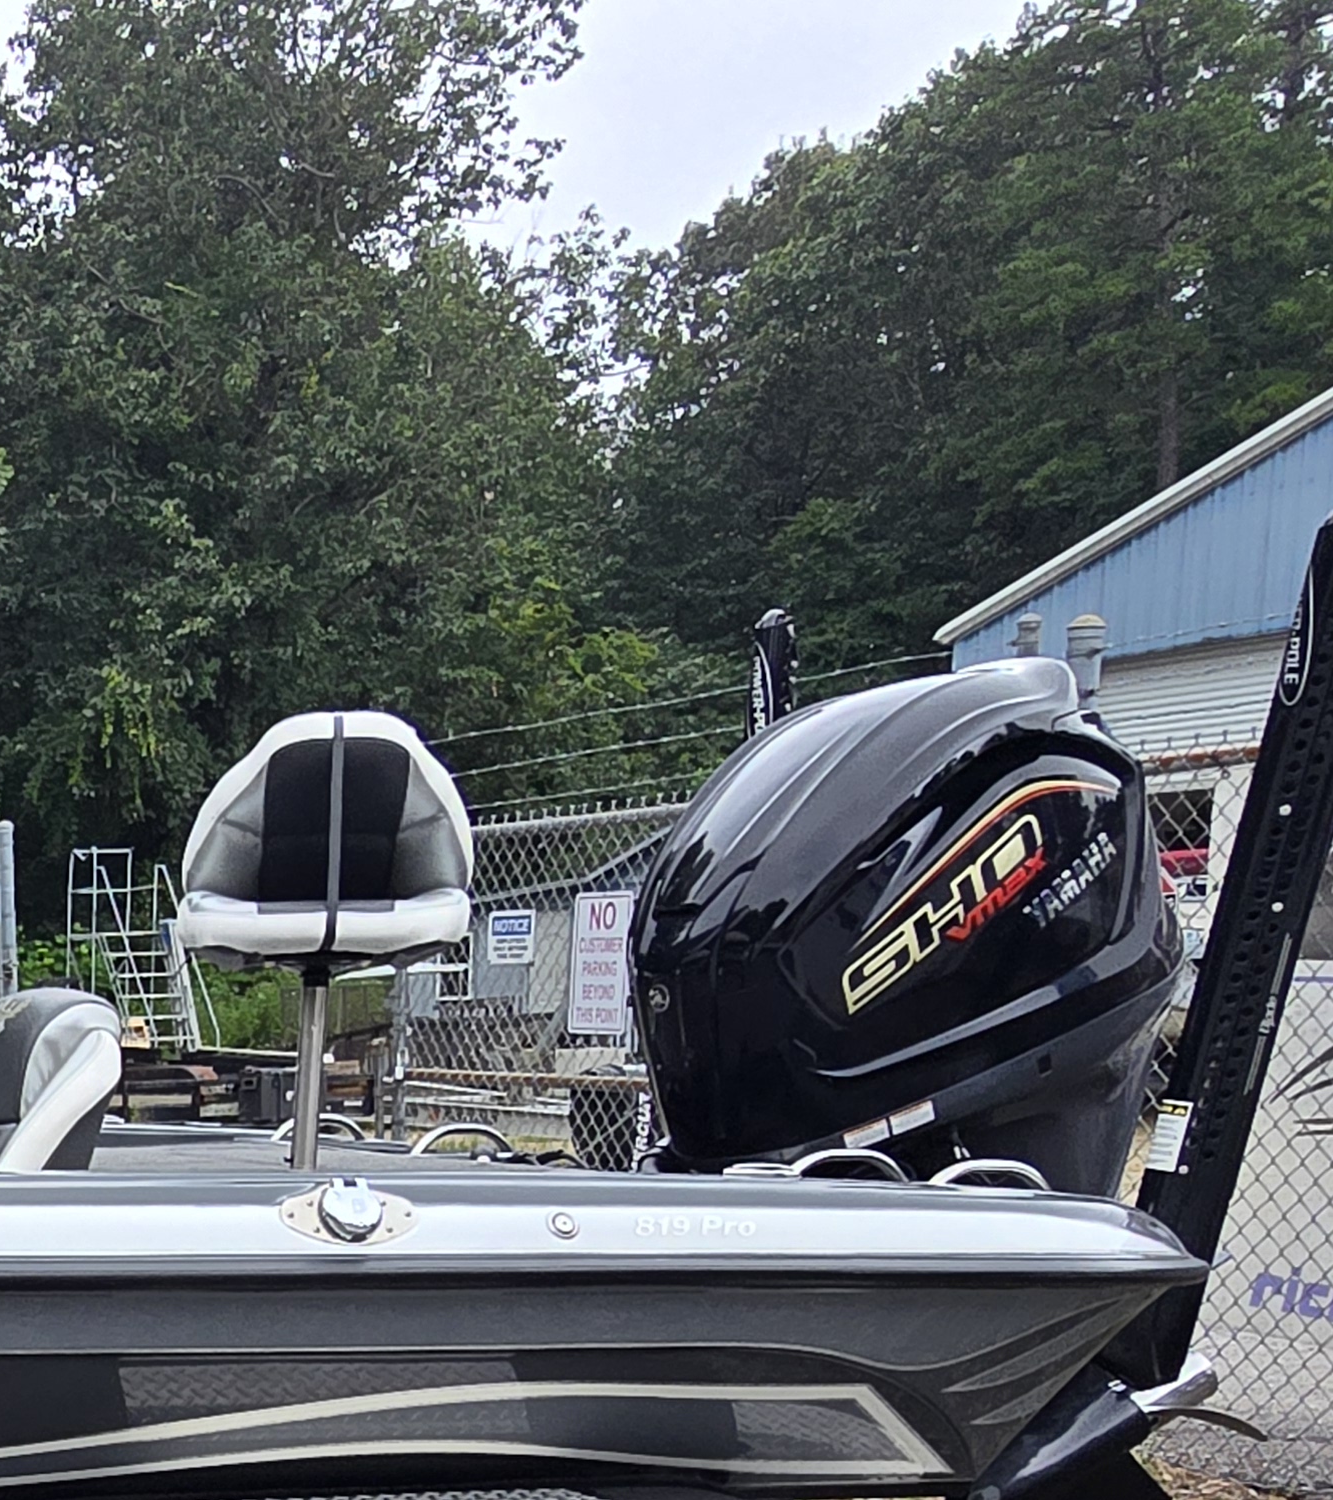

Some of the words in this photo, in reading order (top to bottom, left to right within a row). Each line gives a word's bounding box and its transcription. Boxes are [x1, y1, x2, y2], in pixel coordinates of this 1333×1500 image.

[1022, 832, 1117, 929] YAMAHA
[589, 901, 617, 930] NO
[842, 813, 1044, 1015] SHO
[493, 918, 530, 933] NOTICE
[579, 936, 624, 954] CUSTOMER
[582, 960, 617, 976] PARKING
[582, 984, 615, 1000] BEYOND
[576, 1007, 593, 1023] THIS
[595, 1007, 618, 1023] POINT
[635, 1215, 691, 1237] 819
[700, 1215, 757, 1237] Pro
[1249, 1265, 1333, 1324] ric
